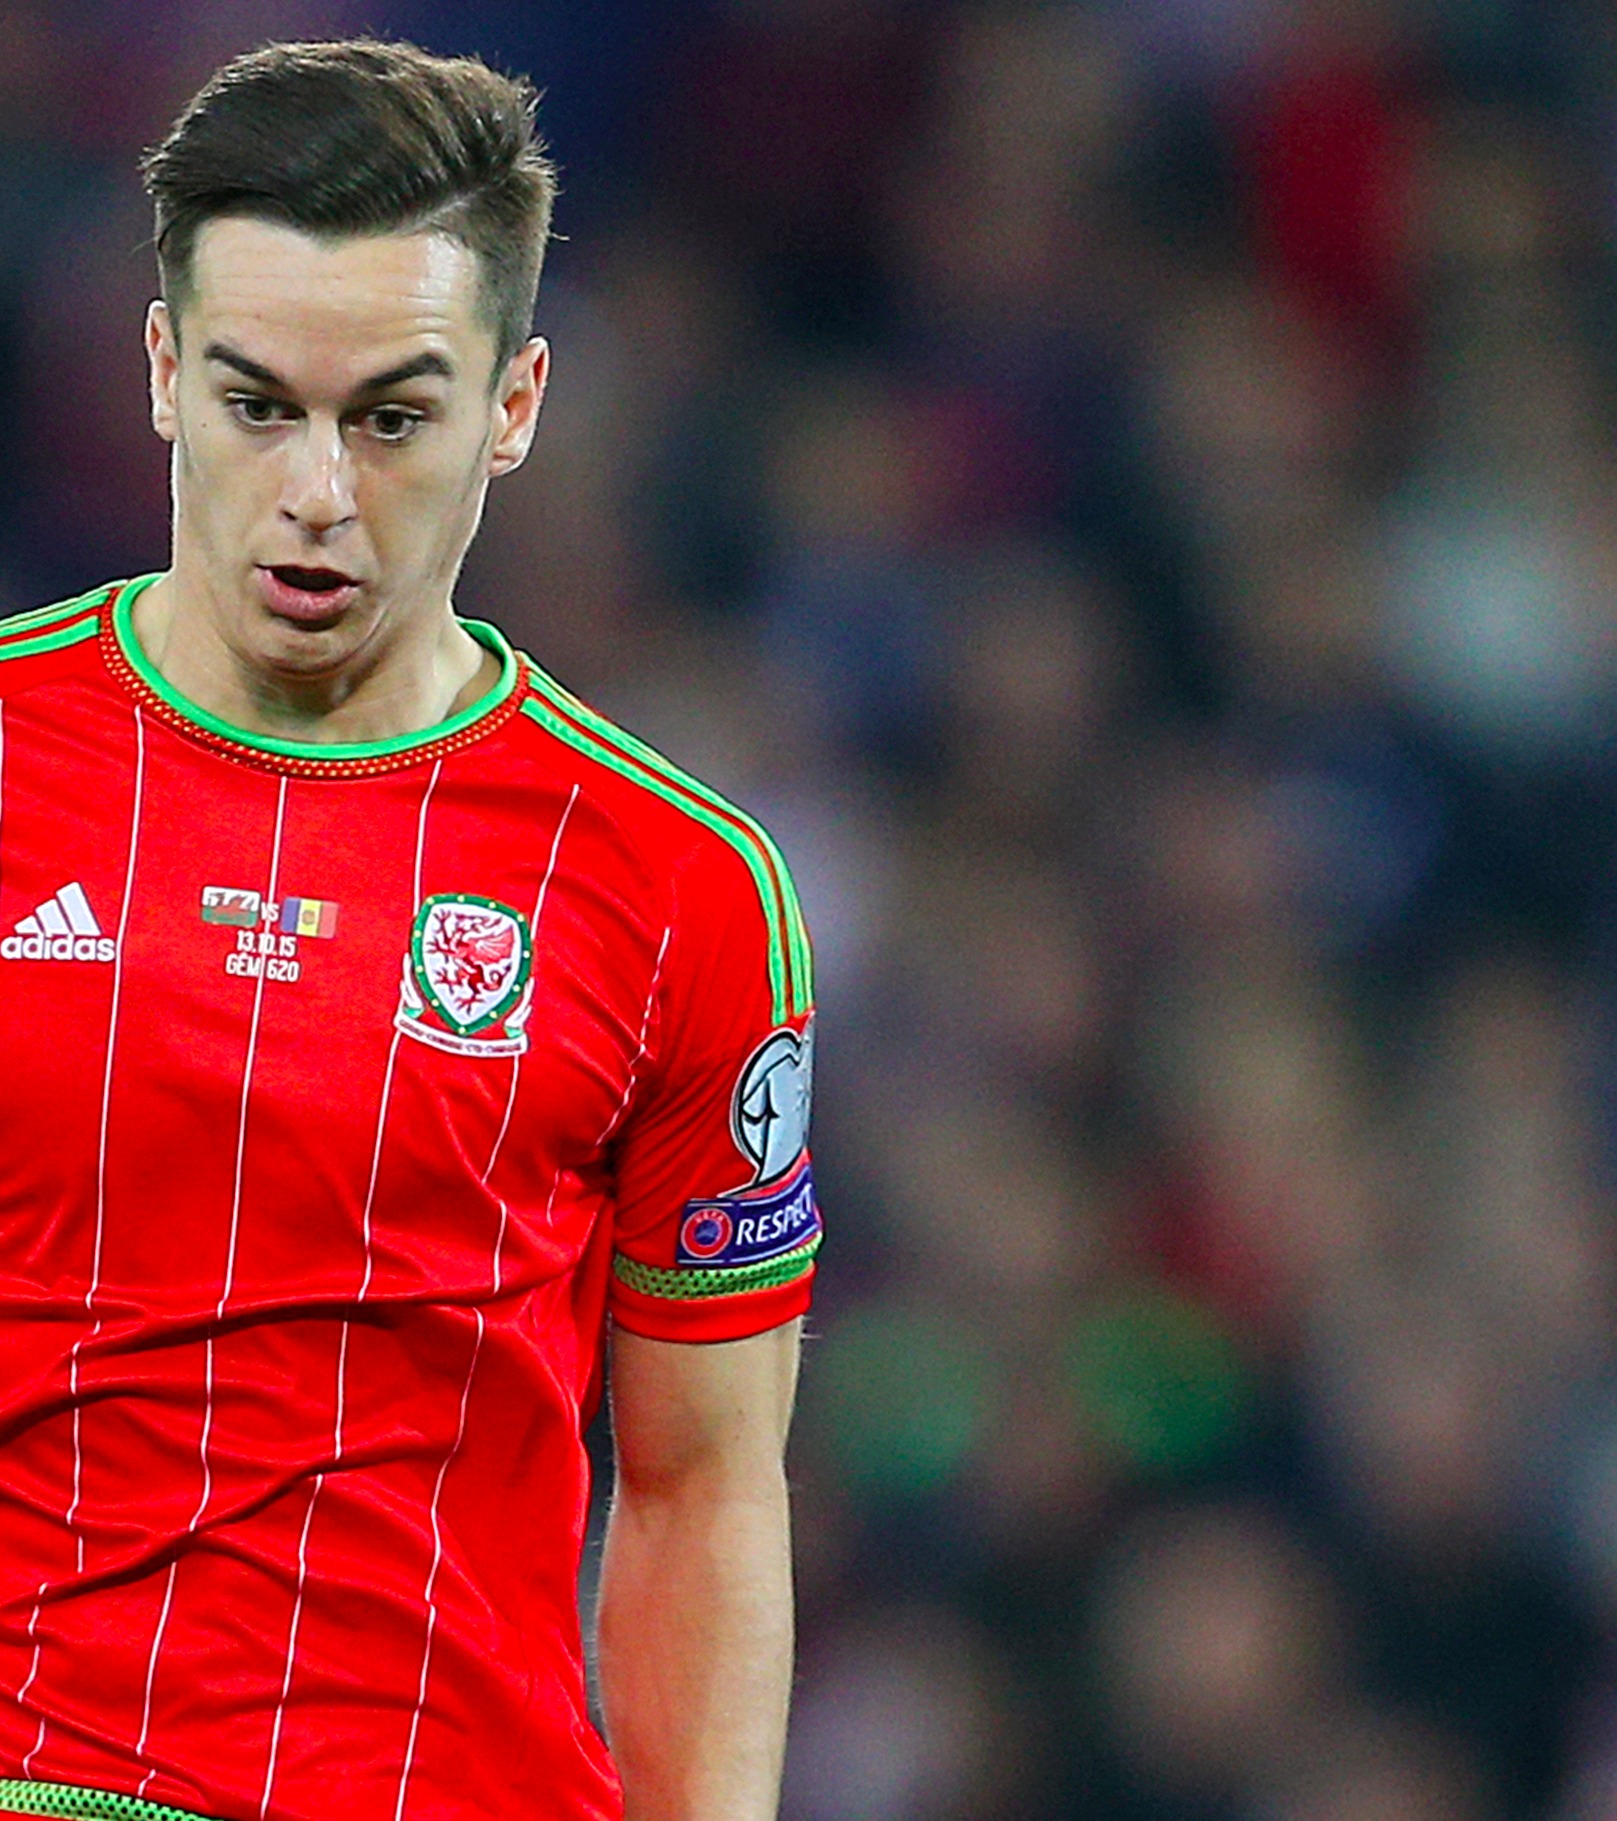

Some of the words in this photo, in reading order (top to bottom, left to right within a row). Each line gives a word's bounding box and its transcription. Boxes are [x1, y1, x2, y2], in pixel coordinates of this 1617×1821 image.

[0, 931, 115, 962] adidas
[237, 929, 297, 957] 13.10.15
[266, 958, 300, 982] 620
